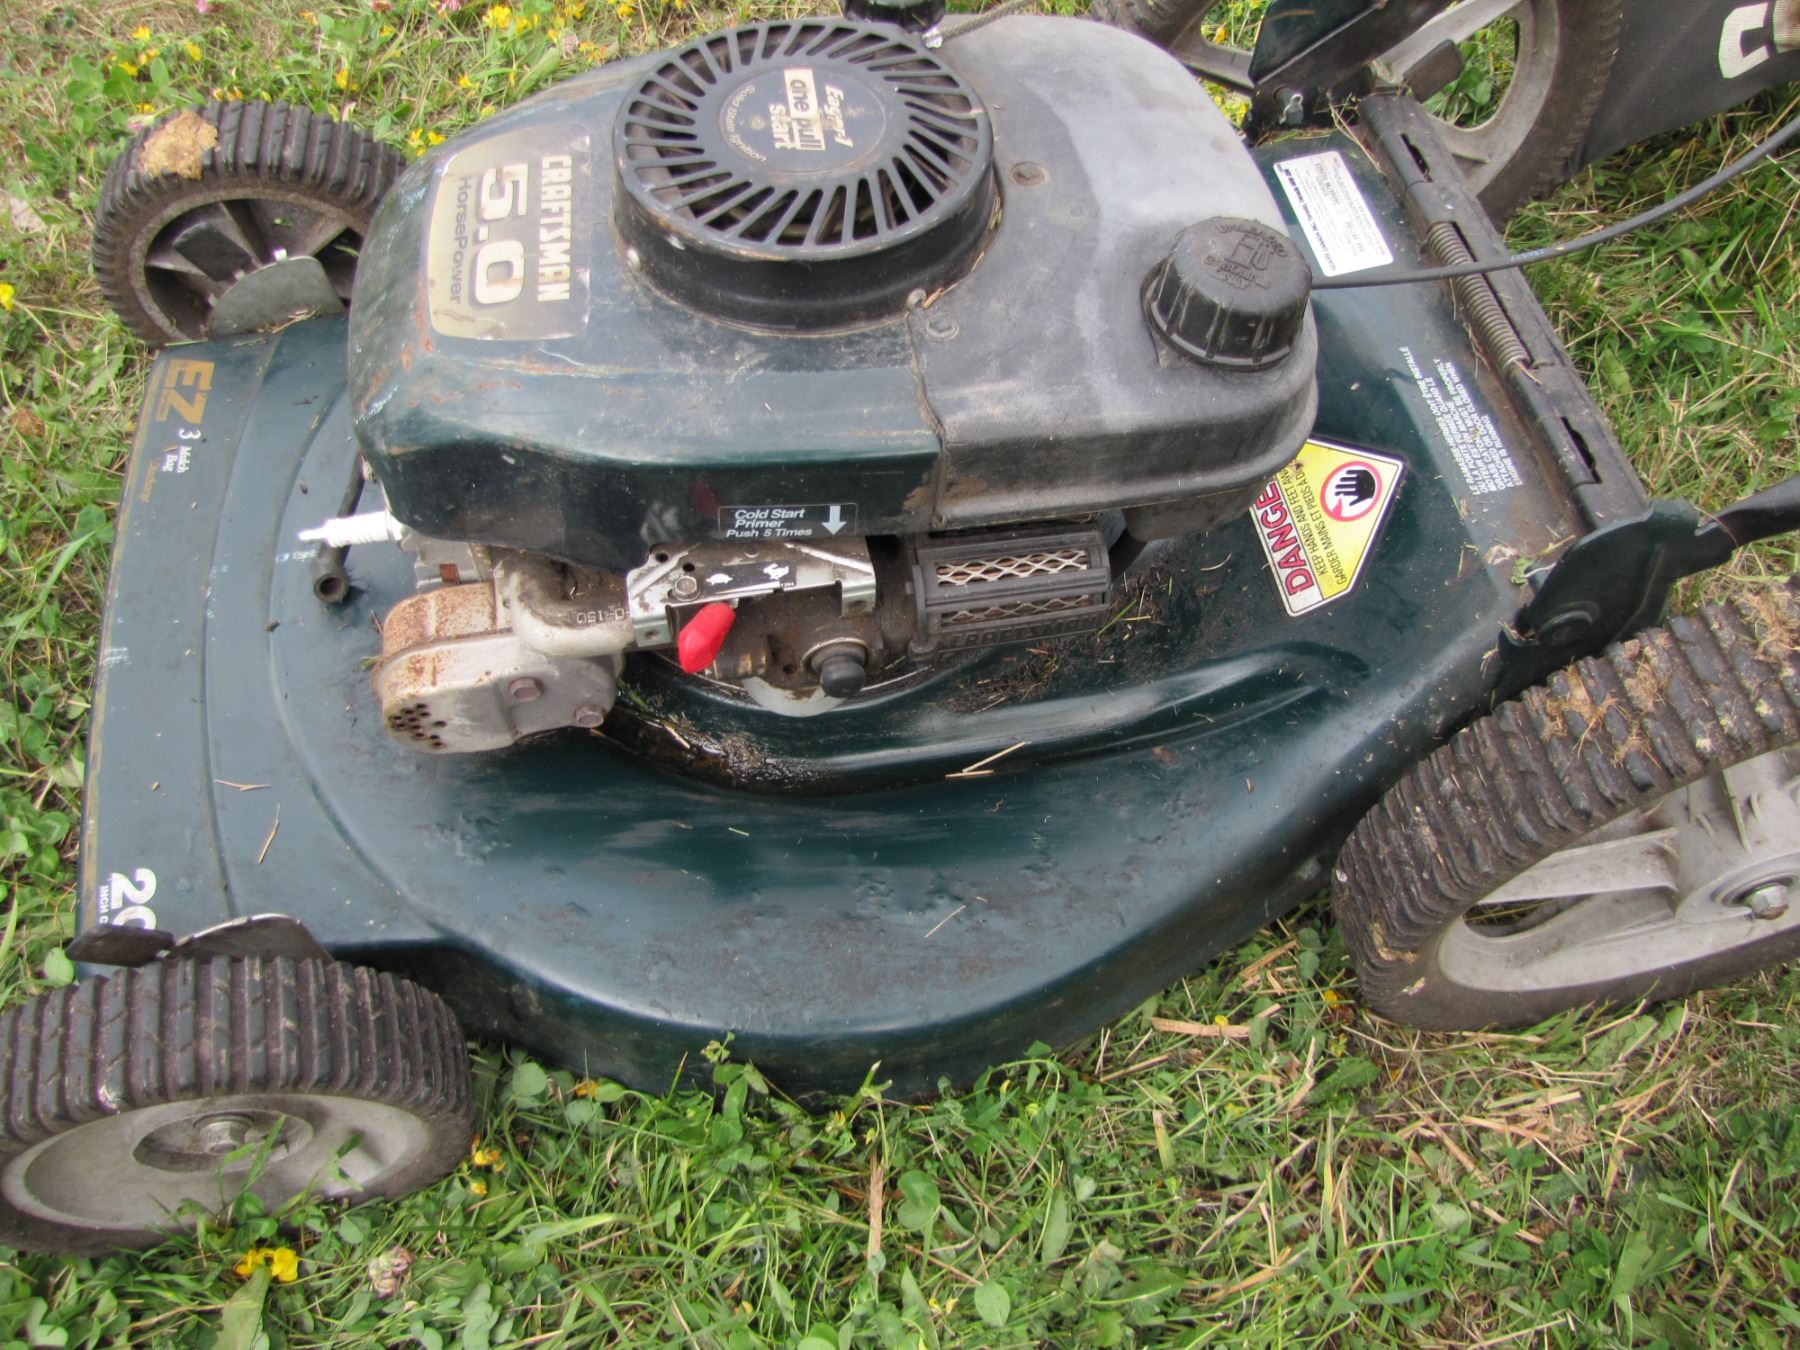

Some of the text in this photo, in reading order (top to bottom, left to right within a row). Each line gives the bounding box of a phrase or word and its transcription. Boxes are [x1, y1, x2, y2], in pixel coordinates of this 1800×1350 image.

[726, 107, 736, 132] State
[790, 79, 822, 148] one pull
[768, 103, 795, 149] start
[450, 176, 473, 304] HorsePower
[473, 163, 528, 305] 5.0
[538, 155, 572, 302] CRAFTSMAN
[1424, 377, 1436, 385] LE
[155, 358, 215, 440] EZ 3
[1452, 396, 1463, 404] BE
[1455, 384, 1475, 411] CLOSED
[1457, 407, 1474, 425] MUST
[1470, 414, 1487, 434] DOOR
[1467, 444, 1480, 457] EST
[1482, 436, 1493, 445] OR
[162, 454, 178, 472] Bag
[177, 446, 192, 473] Mulch
[1488, 448, 1514, 486] ATTACHED
[1471, 471, 1483, 479] LA
[1476, 481, 1489, 492] OU
[1486, 464, 1506, 488] GRASS
[1284, 484, 1299, 504] FEET
[1301, 485, 1317, 509] PIEDS
[1468, 485, 1480, 494] LE
[735, 508, 805, 520] Cold Start
[735, 520, 785, 529] Primer
[1292, 504, 1308, 526] AND
[1310, 508, 1322, 521] ET
[726, 528, 813, 538] Push 5 Times
[1299, 522, 1319, 553] HANDS
[1315, 520, 1333, 550] MAINS
[1311, 552, 1328, 576] KEEP
[1325, 549, 1347, 585] GARDER
[99, 885, 109, 914] INCH
